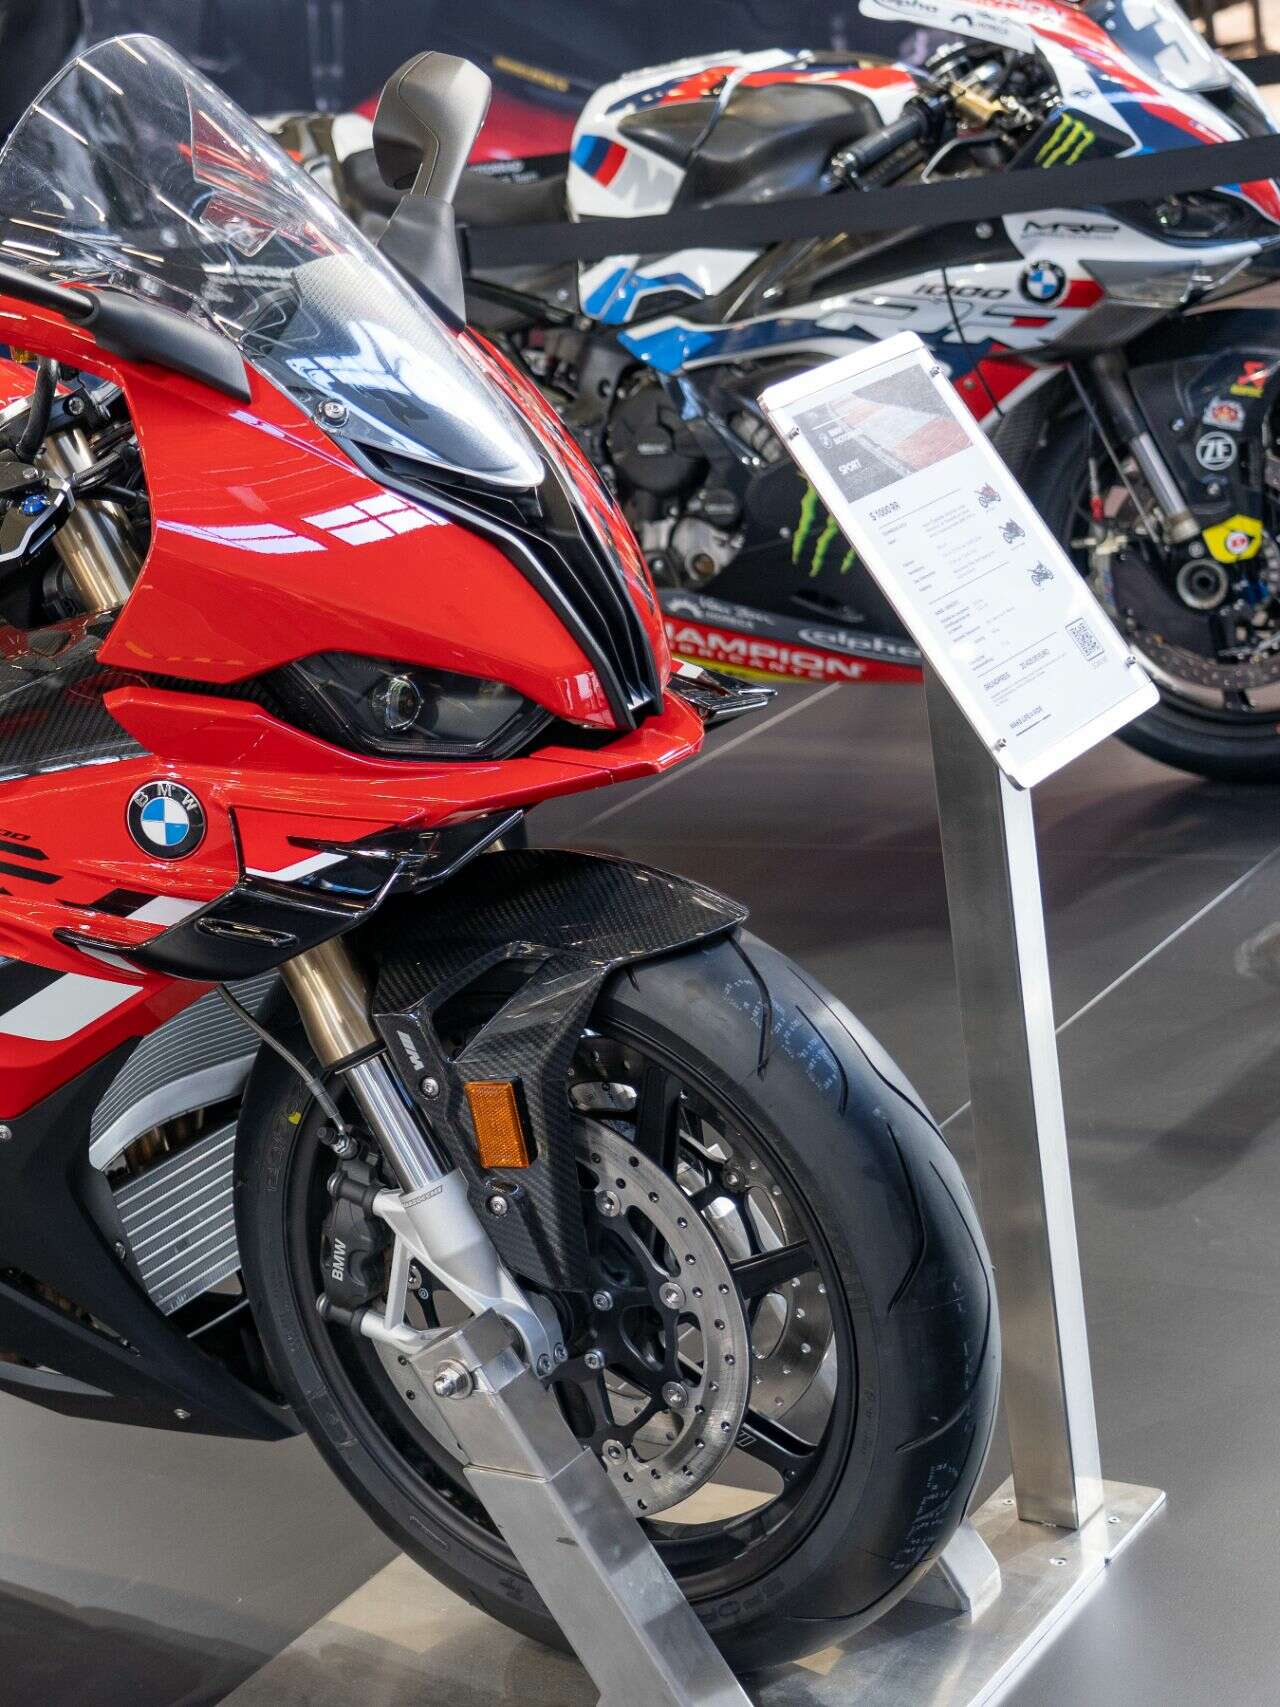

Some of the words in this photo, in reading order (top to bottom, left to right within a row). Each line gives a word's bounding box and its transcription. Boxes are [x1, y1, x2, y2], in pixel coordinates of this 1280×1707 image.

[838, 458, 862, 475] SPORT
[132, 782, 199, 812] BMW
[331, 1237, 346, 1282] BMW
